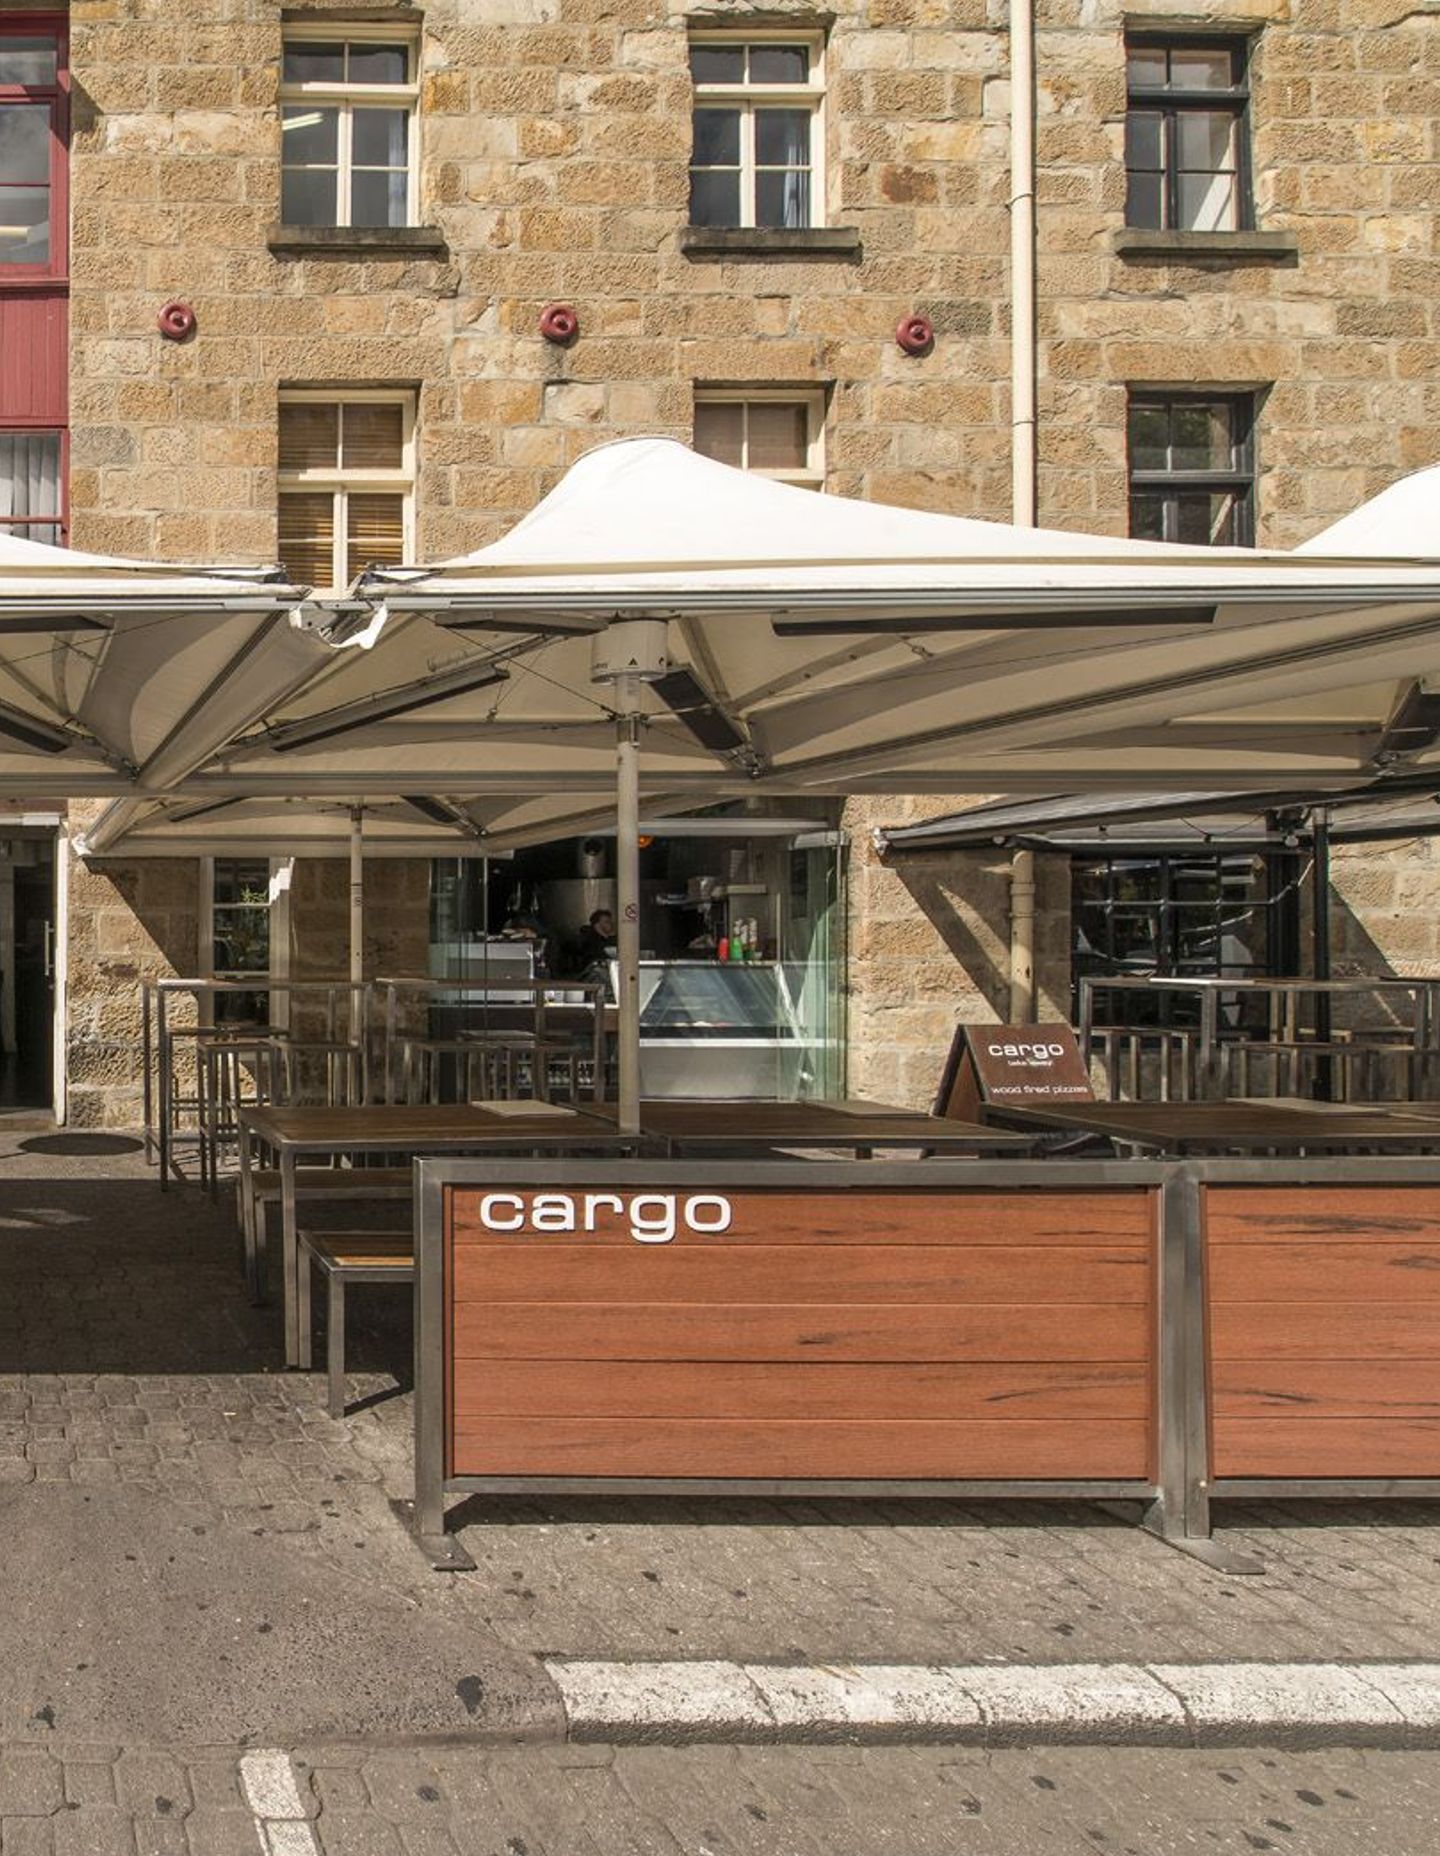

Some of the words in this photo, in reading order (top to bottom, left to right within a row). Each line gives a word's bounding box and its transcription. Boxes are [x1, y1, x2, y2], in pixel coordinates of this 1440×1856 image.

[988, 1043, 1064, 1059] cargo
[991, 1086, 1022, 1094] wood
[479, 1193, 732, 1243] cargo
